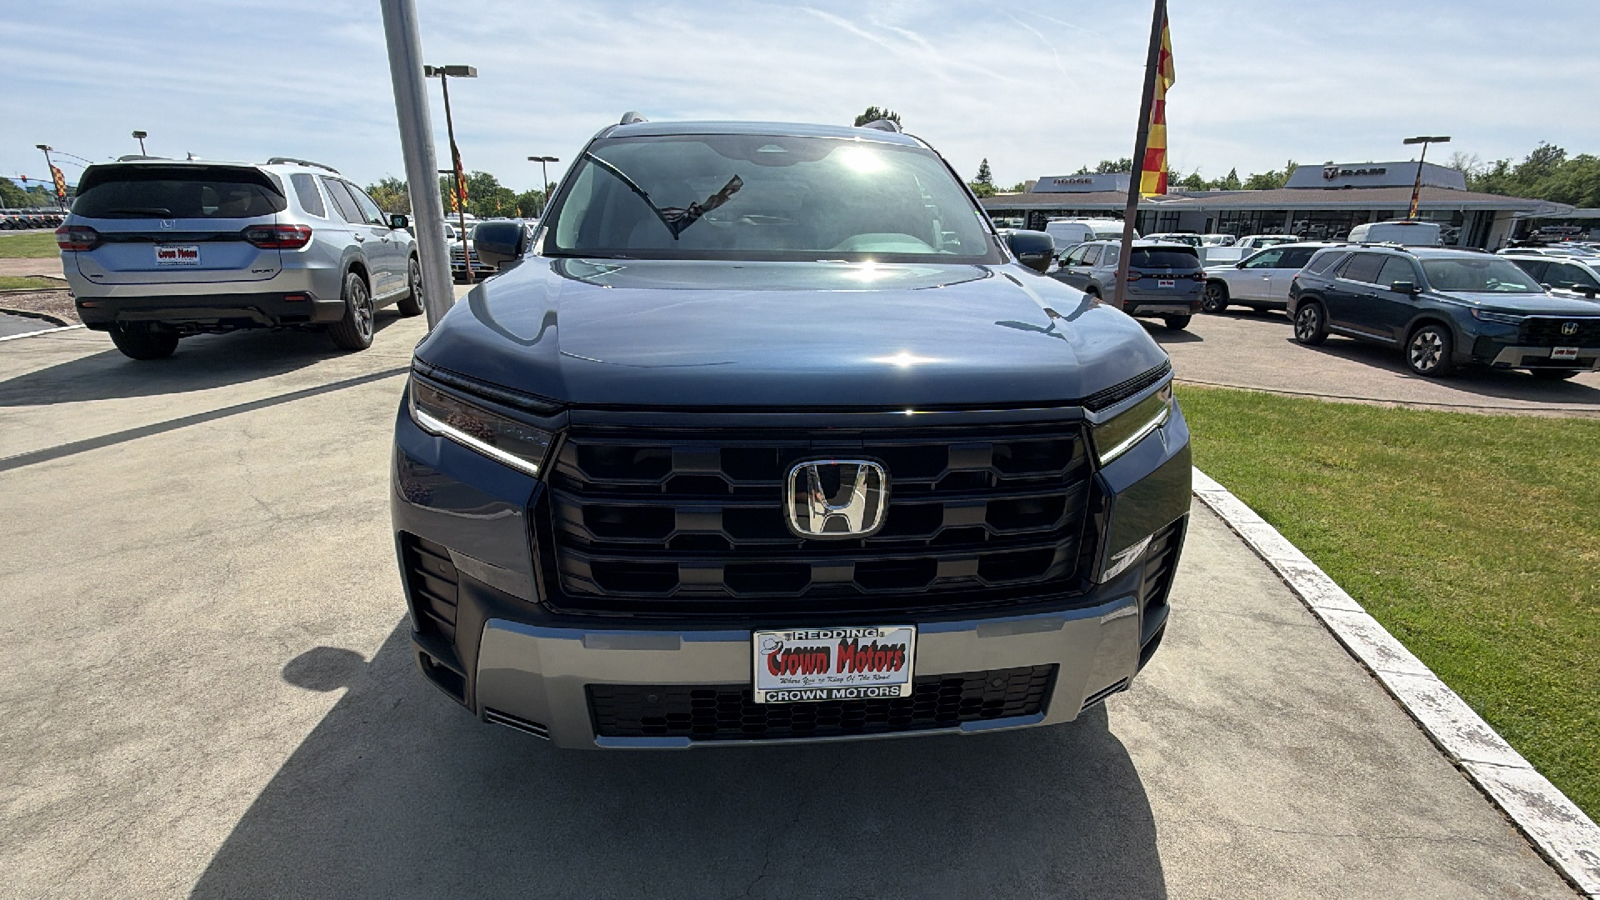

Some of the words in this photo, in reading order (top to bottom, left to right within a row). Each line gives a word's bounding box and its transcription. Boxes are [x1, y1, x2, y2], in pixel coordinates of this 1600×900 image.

[795, 629, 877, 640] REDDING
[767, 641, 830, 676] Crown
[837, 639, 905, 673] Motors
[802, 675, 825, 686] You're
[827, 675, 844, 684] King
[846, 675, 856, 683] Of
[858, 674, 871, 682] The
[872, 673, 891, 681] Road
[766, 689, 828, 702] CROWN
[832, 686, 900, 699] MOTORS
